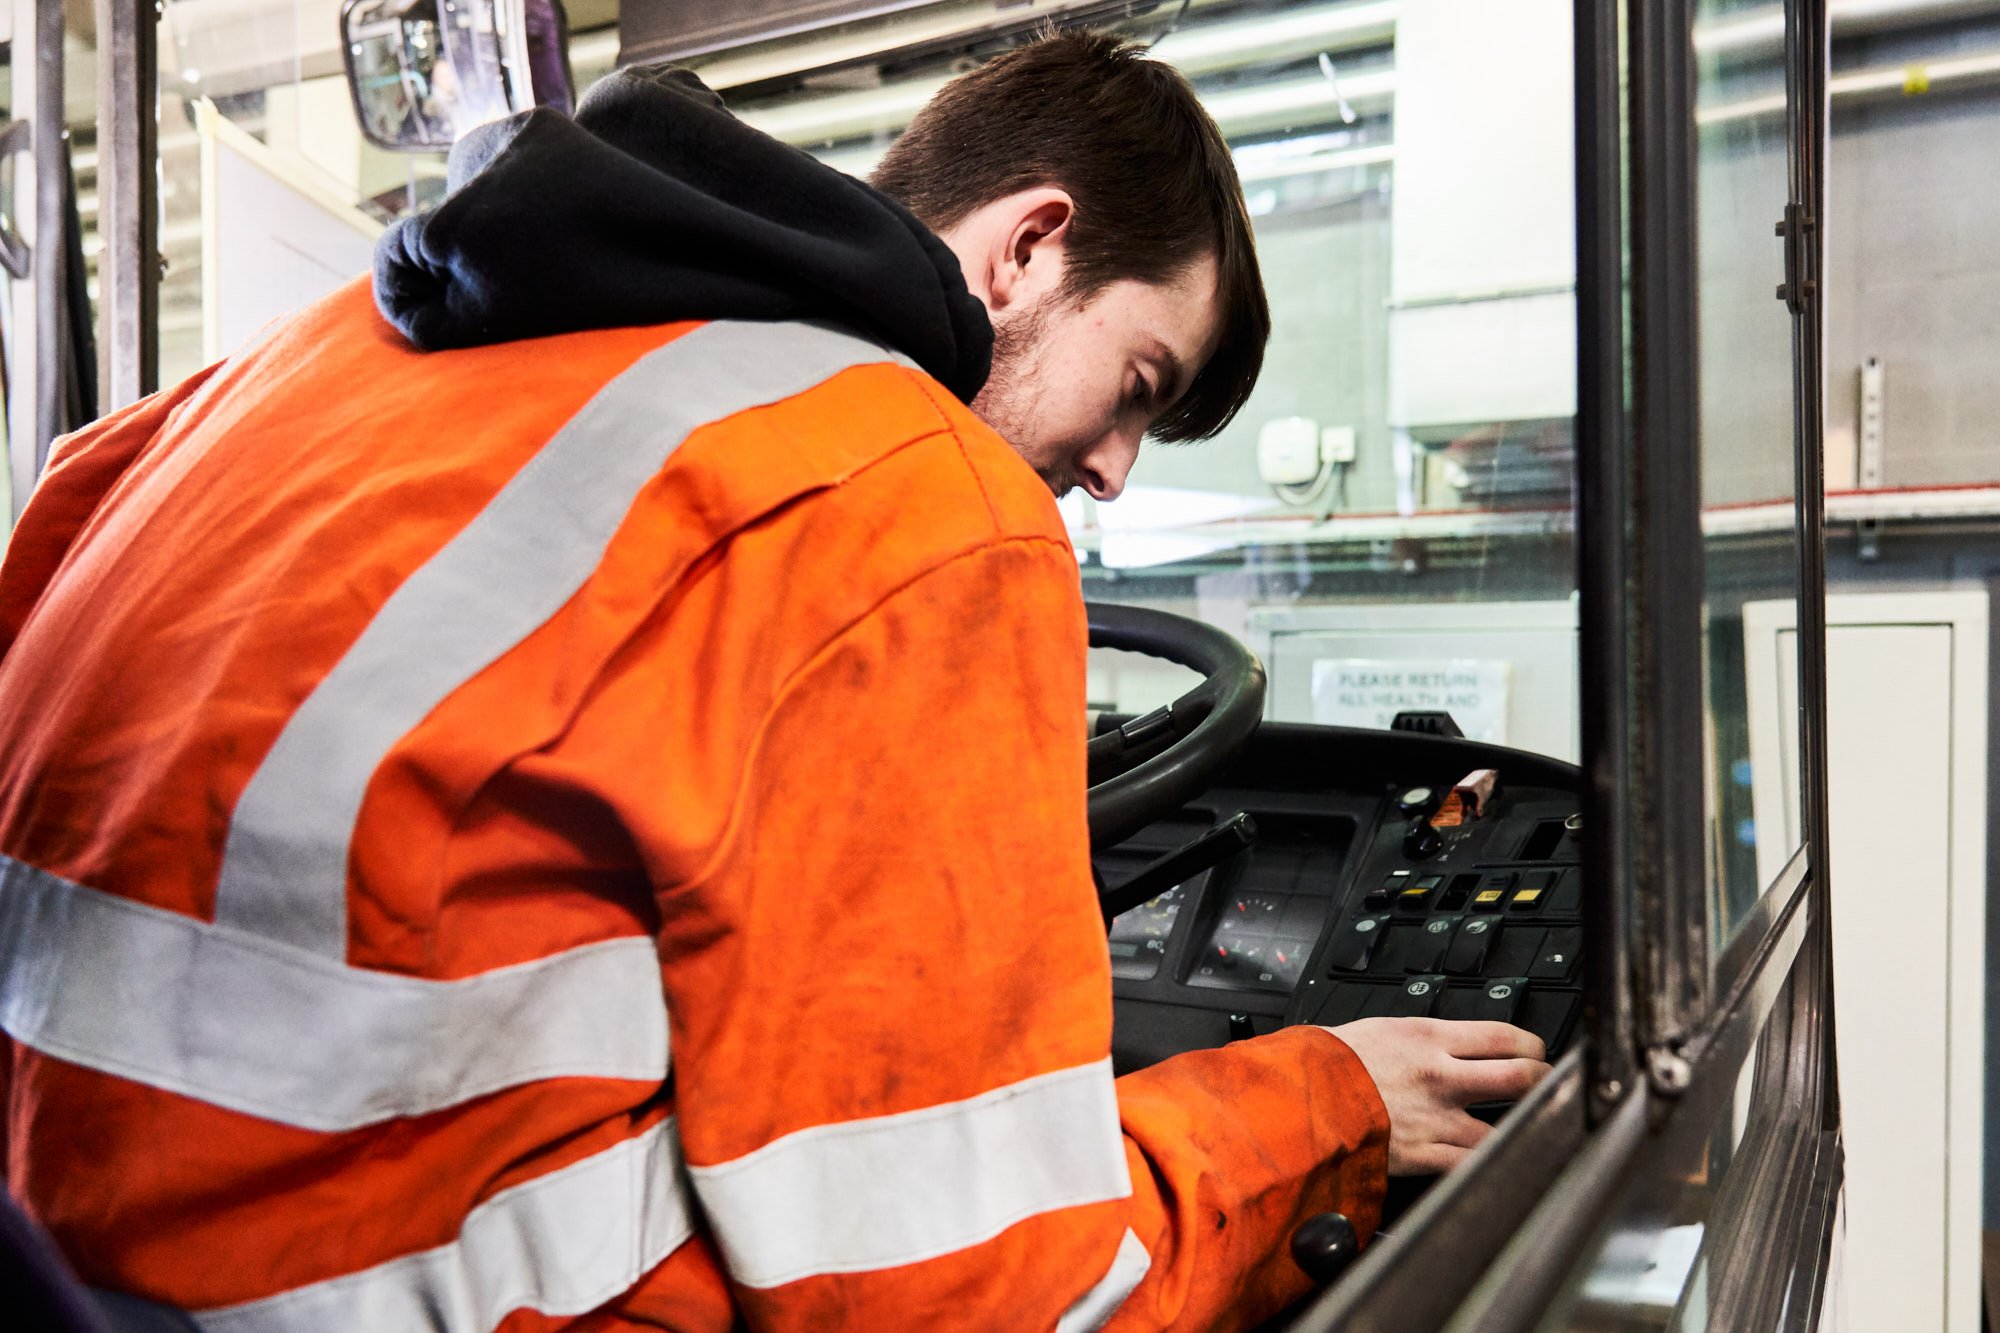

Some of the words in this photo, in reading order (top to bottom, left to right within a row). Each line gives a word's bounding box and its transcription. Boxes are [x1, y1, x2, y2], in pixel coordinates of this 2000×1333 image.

[1339, 672, 1401, 687] PLEASE
[1407, 672, 1478, 687] RETURN
[1338, 693, 1366, 706] ALL
[1372, 693, 1438, 706] HEALTH
[1445, 693, 1480, 707] AND
